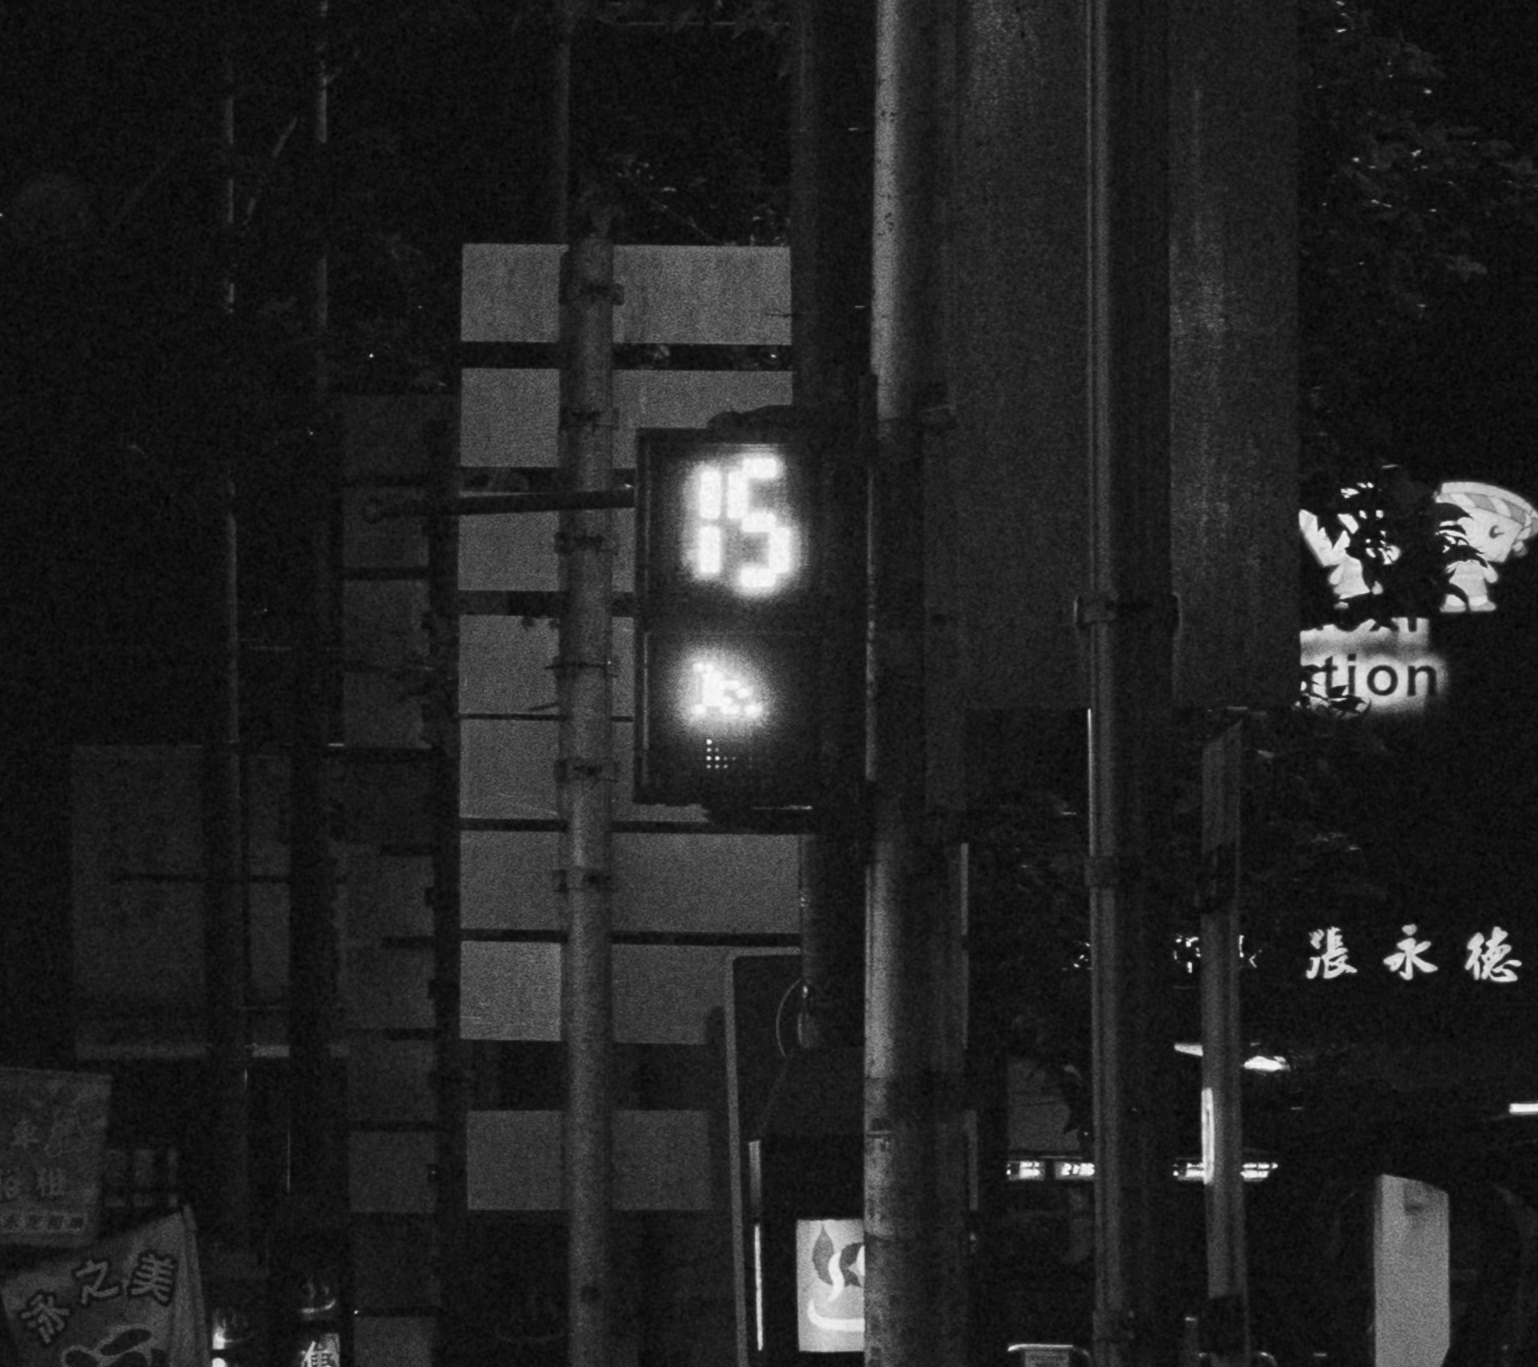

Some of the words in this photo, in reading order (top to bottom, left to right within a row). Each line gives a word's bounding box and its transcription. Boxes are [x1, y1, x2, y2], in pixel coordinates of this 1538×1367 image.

[687, 445, 805, 601] 15
[1305, 923, 1523, 983] 張永德
